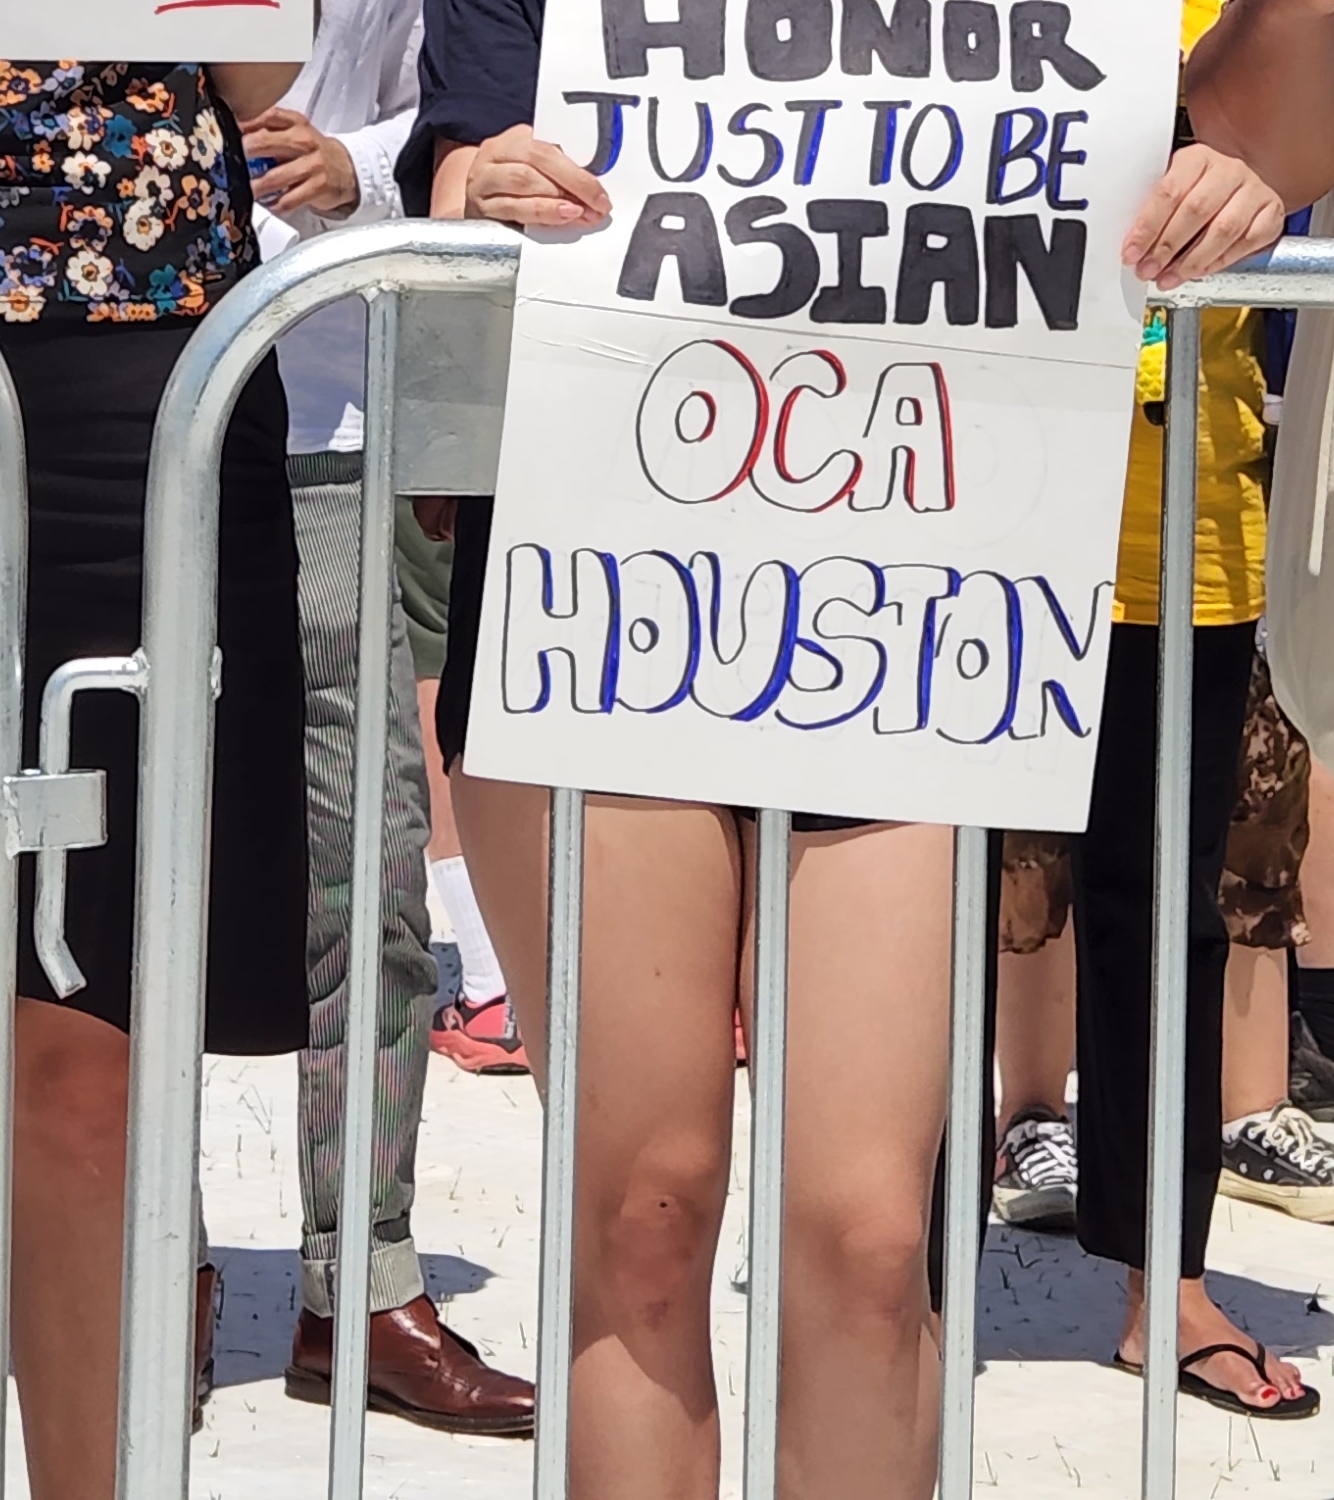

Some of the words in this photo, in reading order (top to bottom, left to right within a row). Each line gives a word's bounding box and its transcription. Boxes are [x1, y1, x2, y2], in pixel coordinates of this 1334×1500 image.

[561, 91, 843, 188] JUST
[863, 99, 964, 191] TO
[986, 106, 1089, 210] BE
[616, 192, 1087, 330] ASIAN
[636, 339, 955, 513] OCA
[502, 543, 1114, 745] HOUSTON
